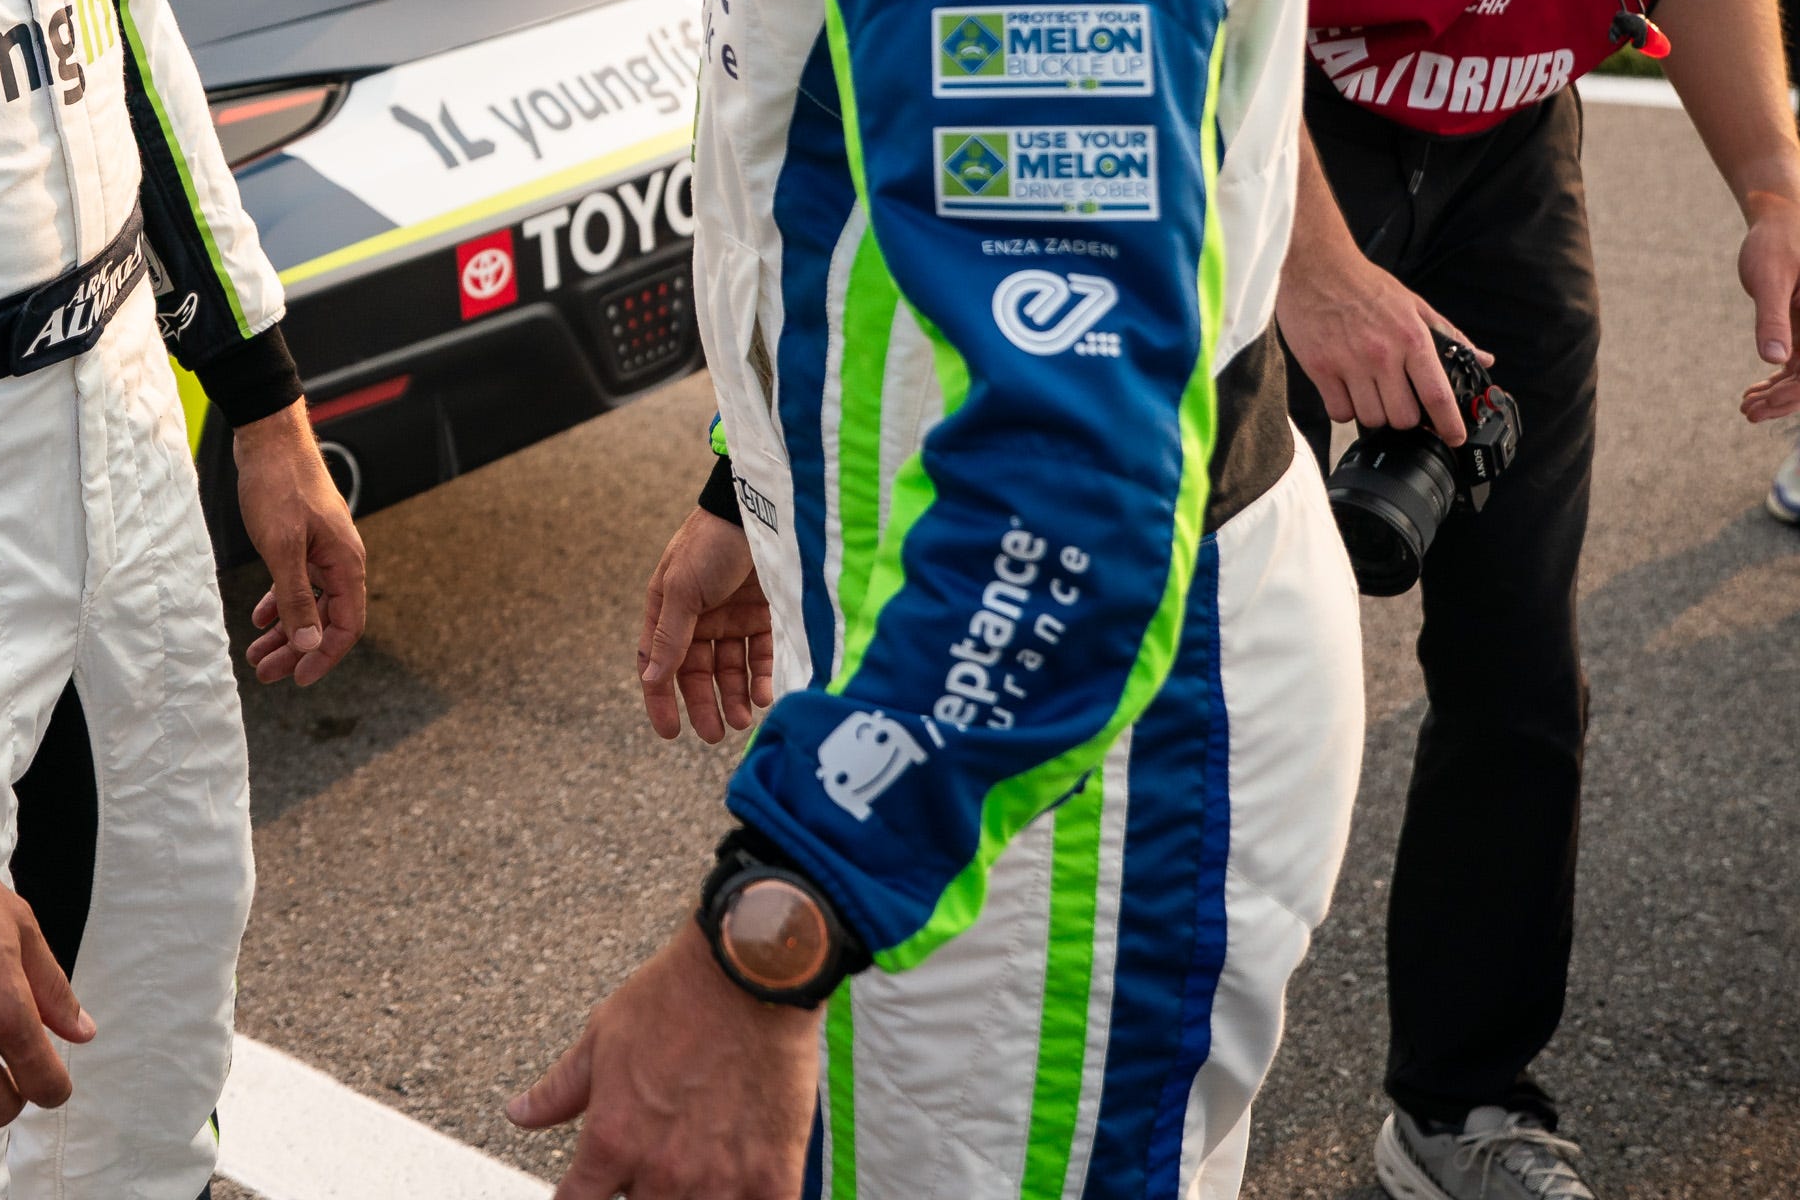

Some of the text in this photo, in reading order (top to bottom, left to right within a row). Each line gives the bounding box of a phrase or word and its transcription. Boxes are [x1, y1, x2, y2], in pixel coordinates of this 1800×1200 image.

[1007, 11, 1141, 24] PROTECT YOUR
[1008, 27, 1144, 55] MELON
[1007, 55, 1144, 77] BUCKLE UP
[1015, 131, 1146, 150] USE YOUR
[1017, 152, 1148, 180] MELON
[1015, 180, 1149, 200] DRIVE SOBER
[981, 237, 1119, 260] ENZA ZADEN
[1473, 448, 1487, 479] SONY
[928, 528, 1048, 736] eptance
